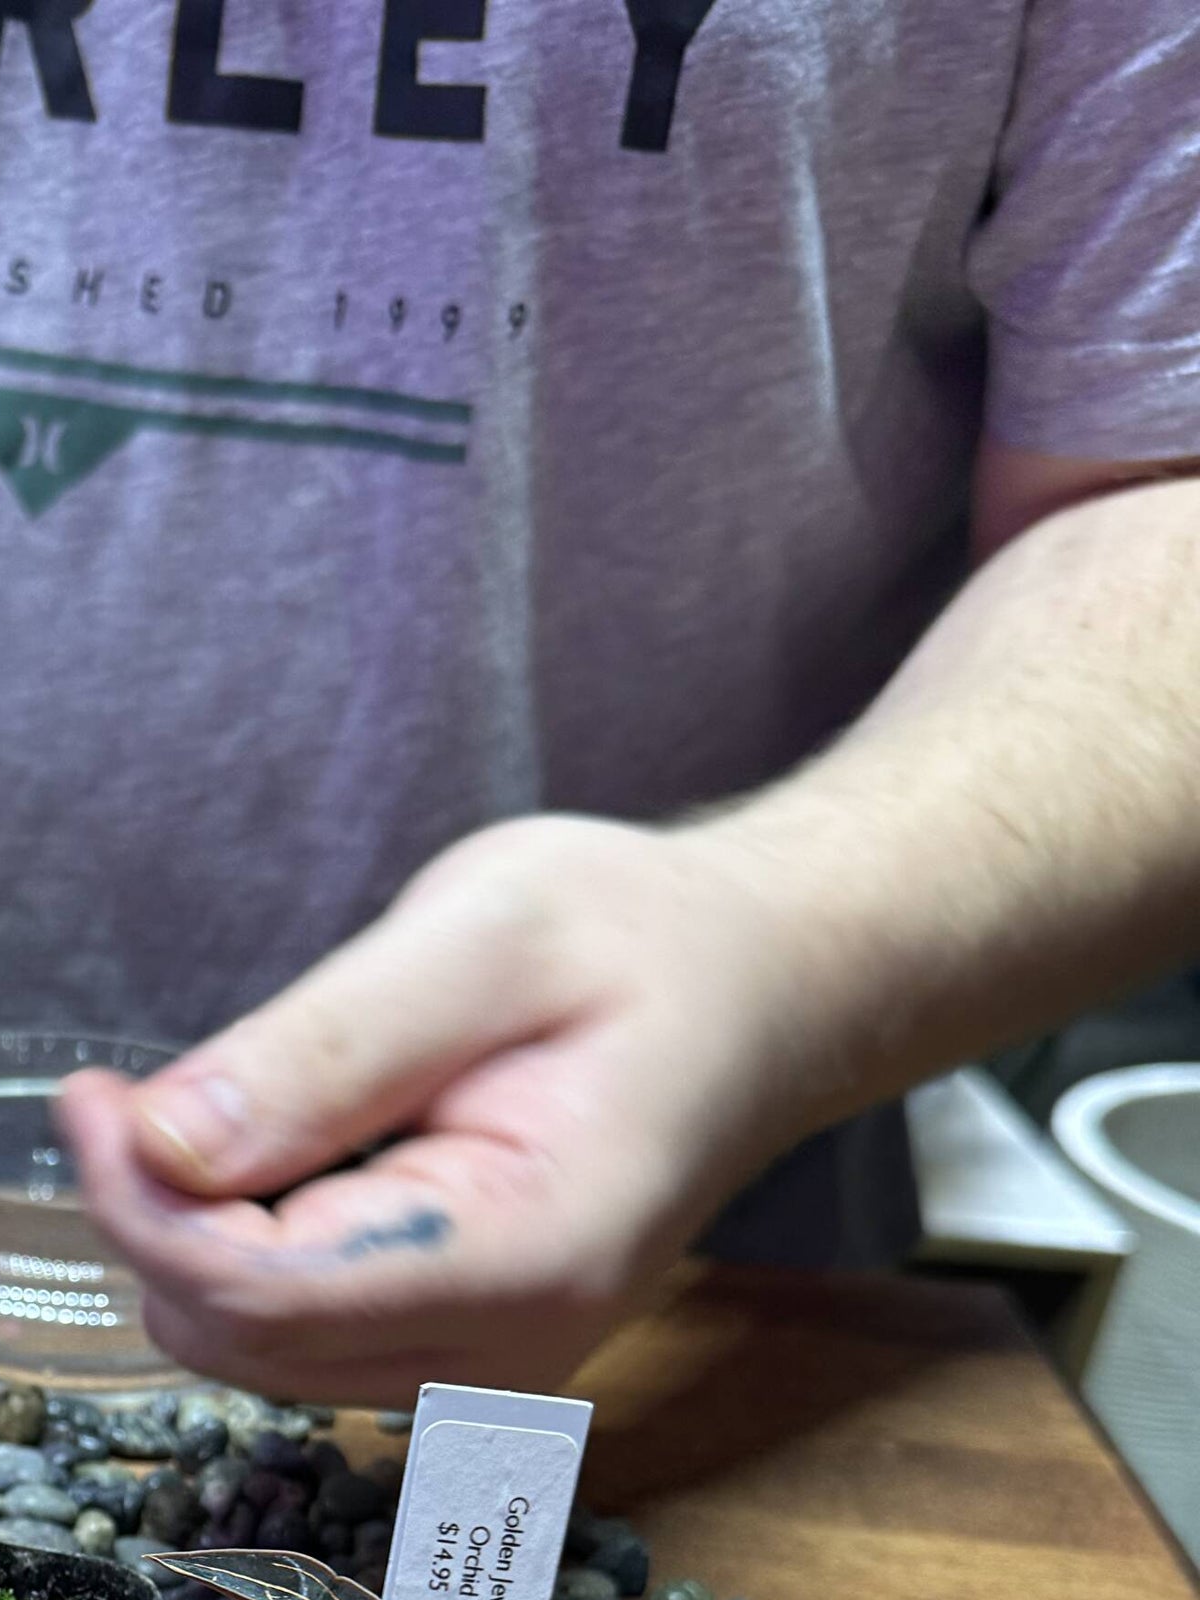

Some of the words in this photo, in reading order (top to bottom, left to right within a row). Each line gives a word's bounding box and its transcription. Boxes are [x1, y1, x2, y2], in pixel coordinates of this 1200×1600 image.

[333, 290, 528, 343] 1999
[428, 1521, 461, 1592] $14.95
[458, 1525, 492, 1597] Orchid
[495, 1496, 530, 1572] Golden
